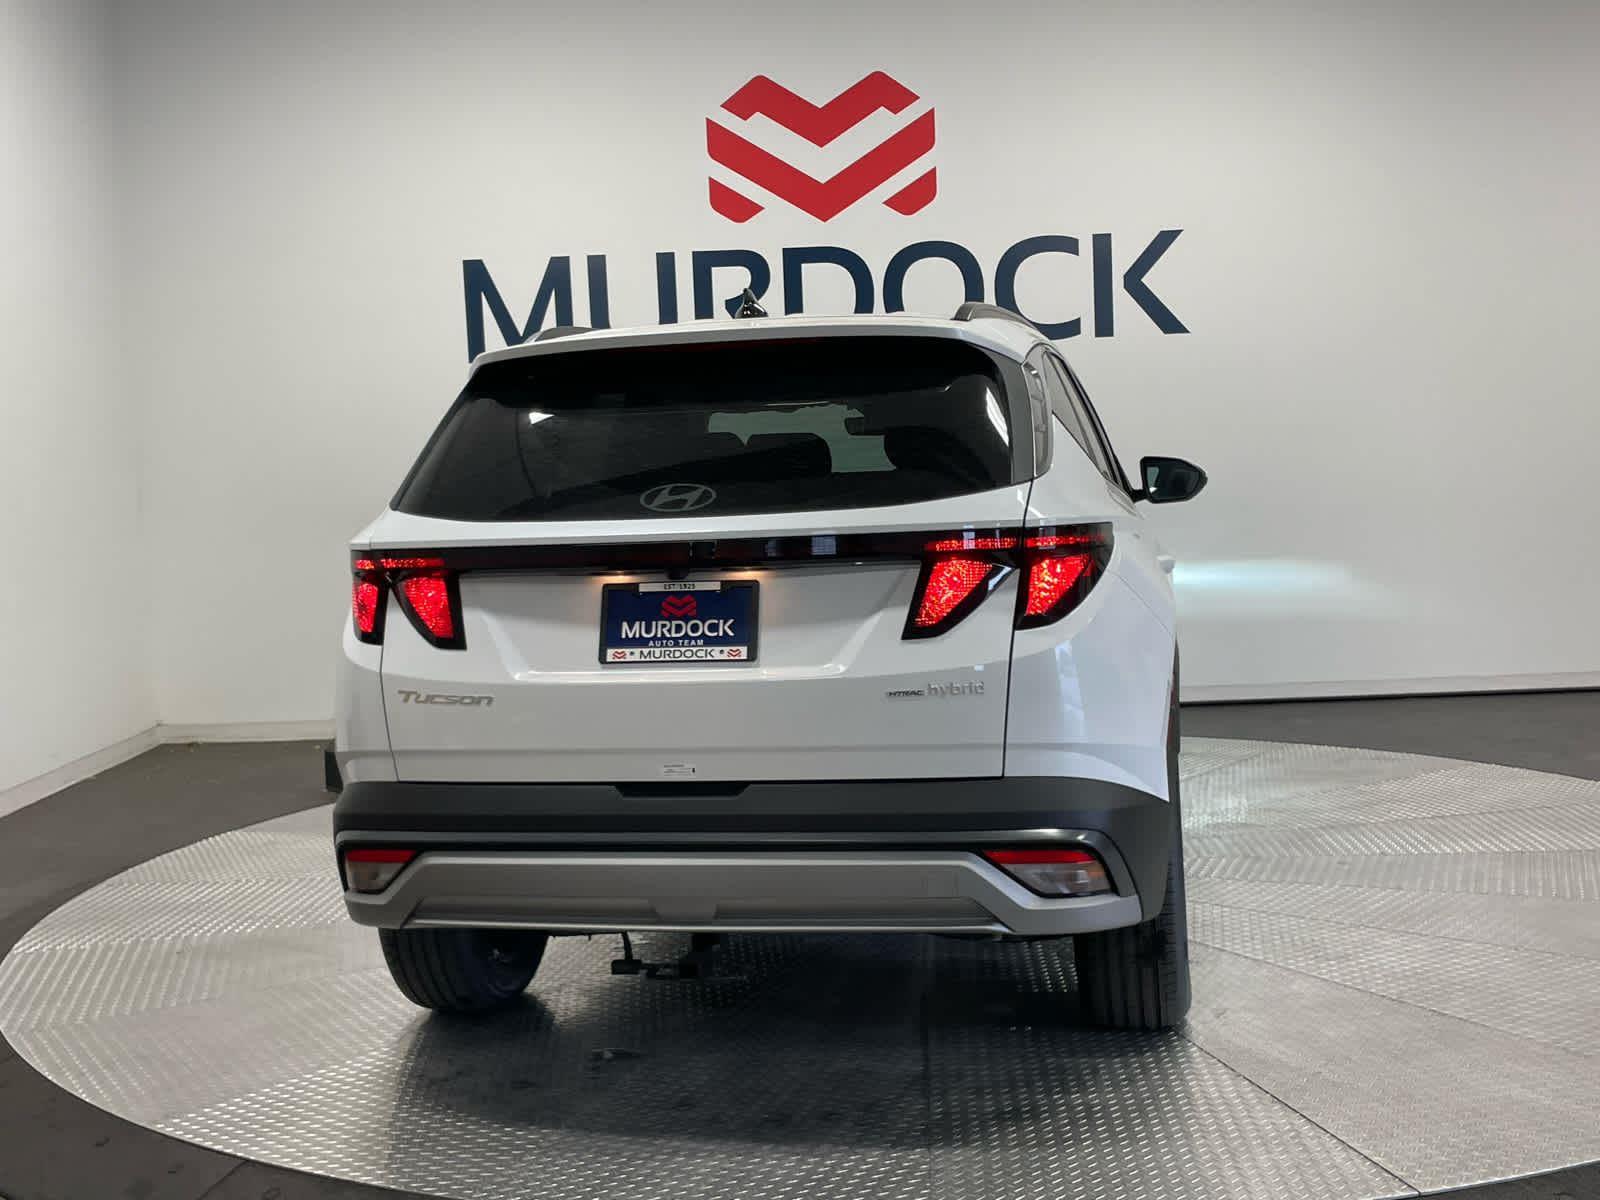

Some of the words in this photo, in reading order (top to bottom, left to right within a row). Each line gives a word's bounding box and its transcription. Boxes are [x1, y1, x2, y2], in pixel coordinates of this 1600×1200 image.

[461, 229, 1190, 363] MURDOCK
[621, 619, 735, 639] MURDOCK
[648, 640, 674, 648] AUTO
[679, 639, 704, 647] TEAM
[640, 648, 715, 660] MURDOCK
[926, 680, 985, 698] hybrid
